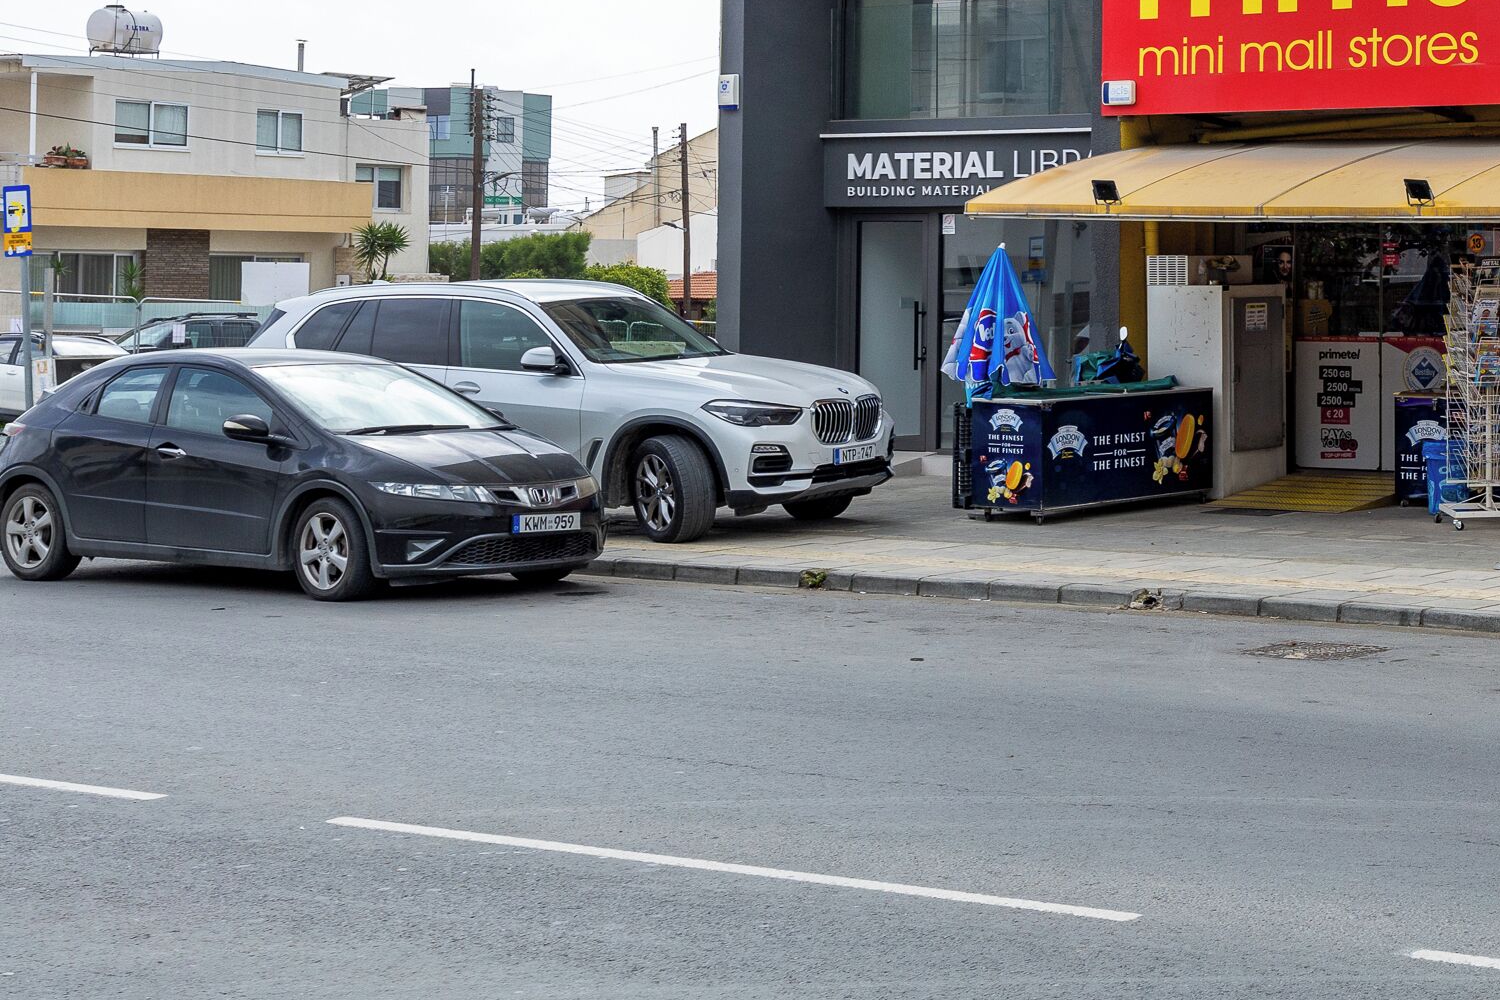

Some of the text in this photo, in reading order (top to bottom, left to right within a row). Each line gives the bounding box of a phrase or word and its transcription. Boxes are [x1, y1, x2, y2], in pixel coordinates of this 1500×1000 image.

[1139, 27, 1479, 77] mini mall stores
[847, 150, 1005, 180] MATERIAL
[847, 186, 915, 197] BUILDING
[1319, 348, 1361, 360] primetel
[1322, 368, 1351, 378] 250 GB
[1327, 382, 1348, 392] 2500
[1321, 396, 1342, 405] 2500
[1321, 428, 1343, 440] PAY
[1414, 426, 1441, 435] LONDON
[1002, 434, 1024, 442] FINEST
[1055, 433, 1080, 442] LONDON
[1093, 431, 1146, 446] THE FINEST
[842, 445, 873, 462] NTP 747
[1002, 447, 1024, 455] FINEST
[1113, 448, 1127, 457] FOR
[1400, 454, 1418, 462] THE
[1093, 456, 1146, 471] THE FINEST
[1400, 472, 1418, 480] THE
[524, 515, 548, 531] KWM
[554, 515, 575, 529] 959
